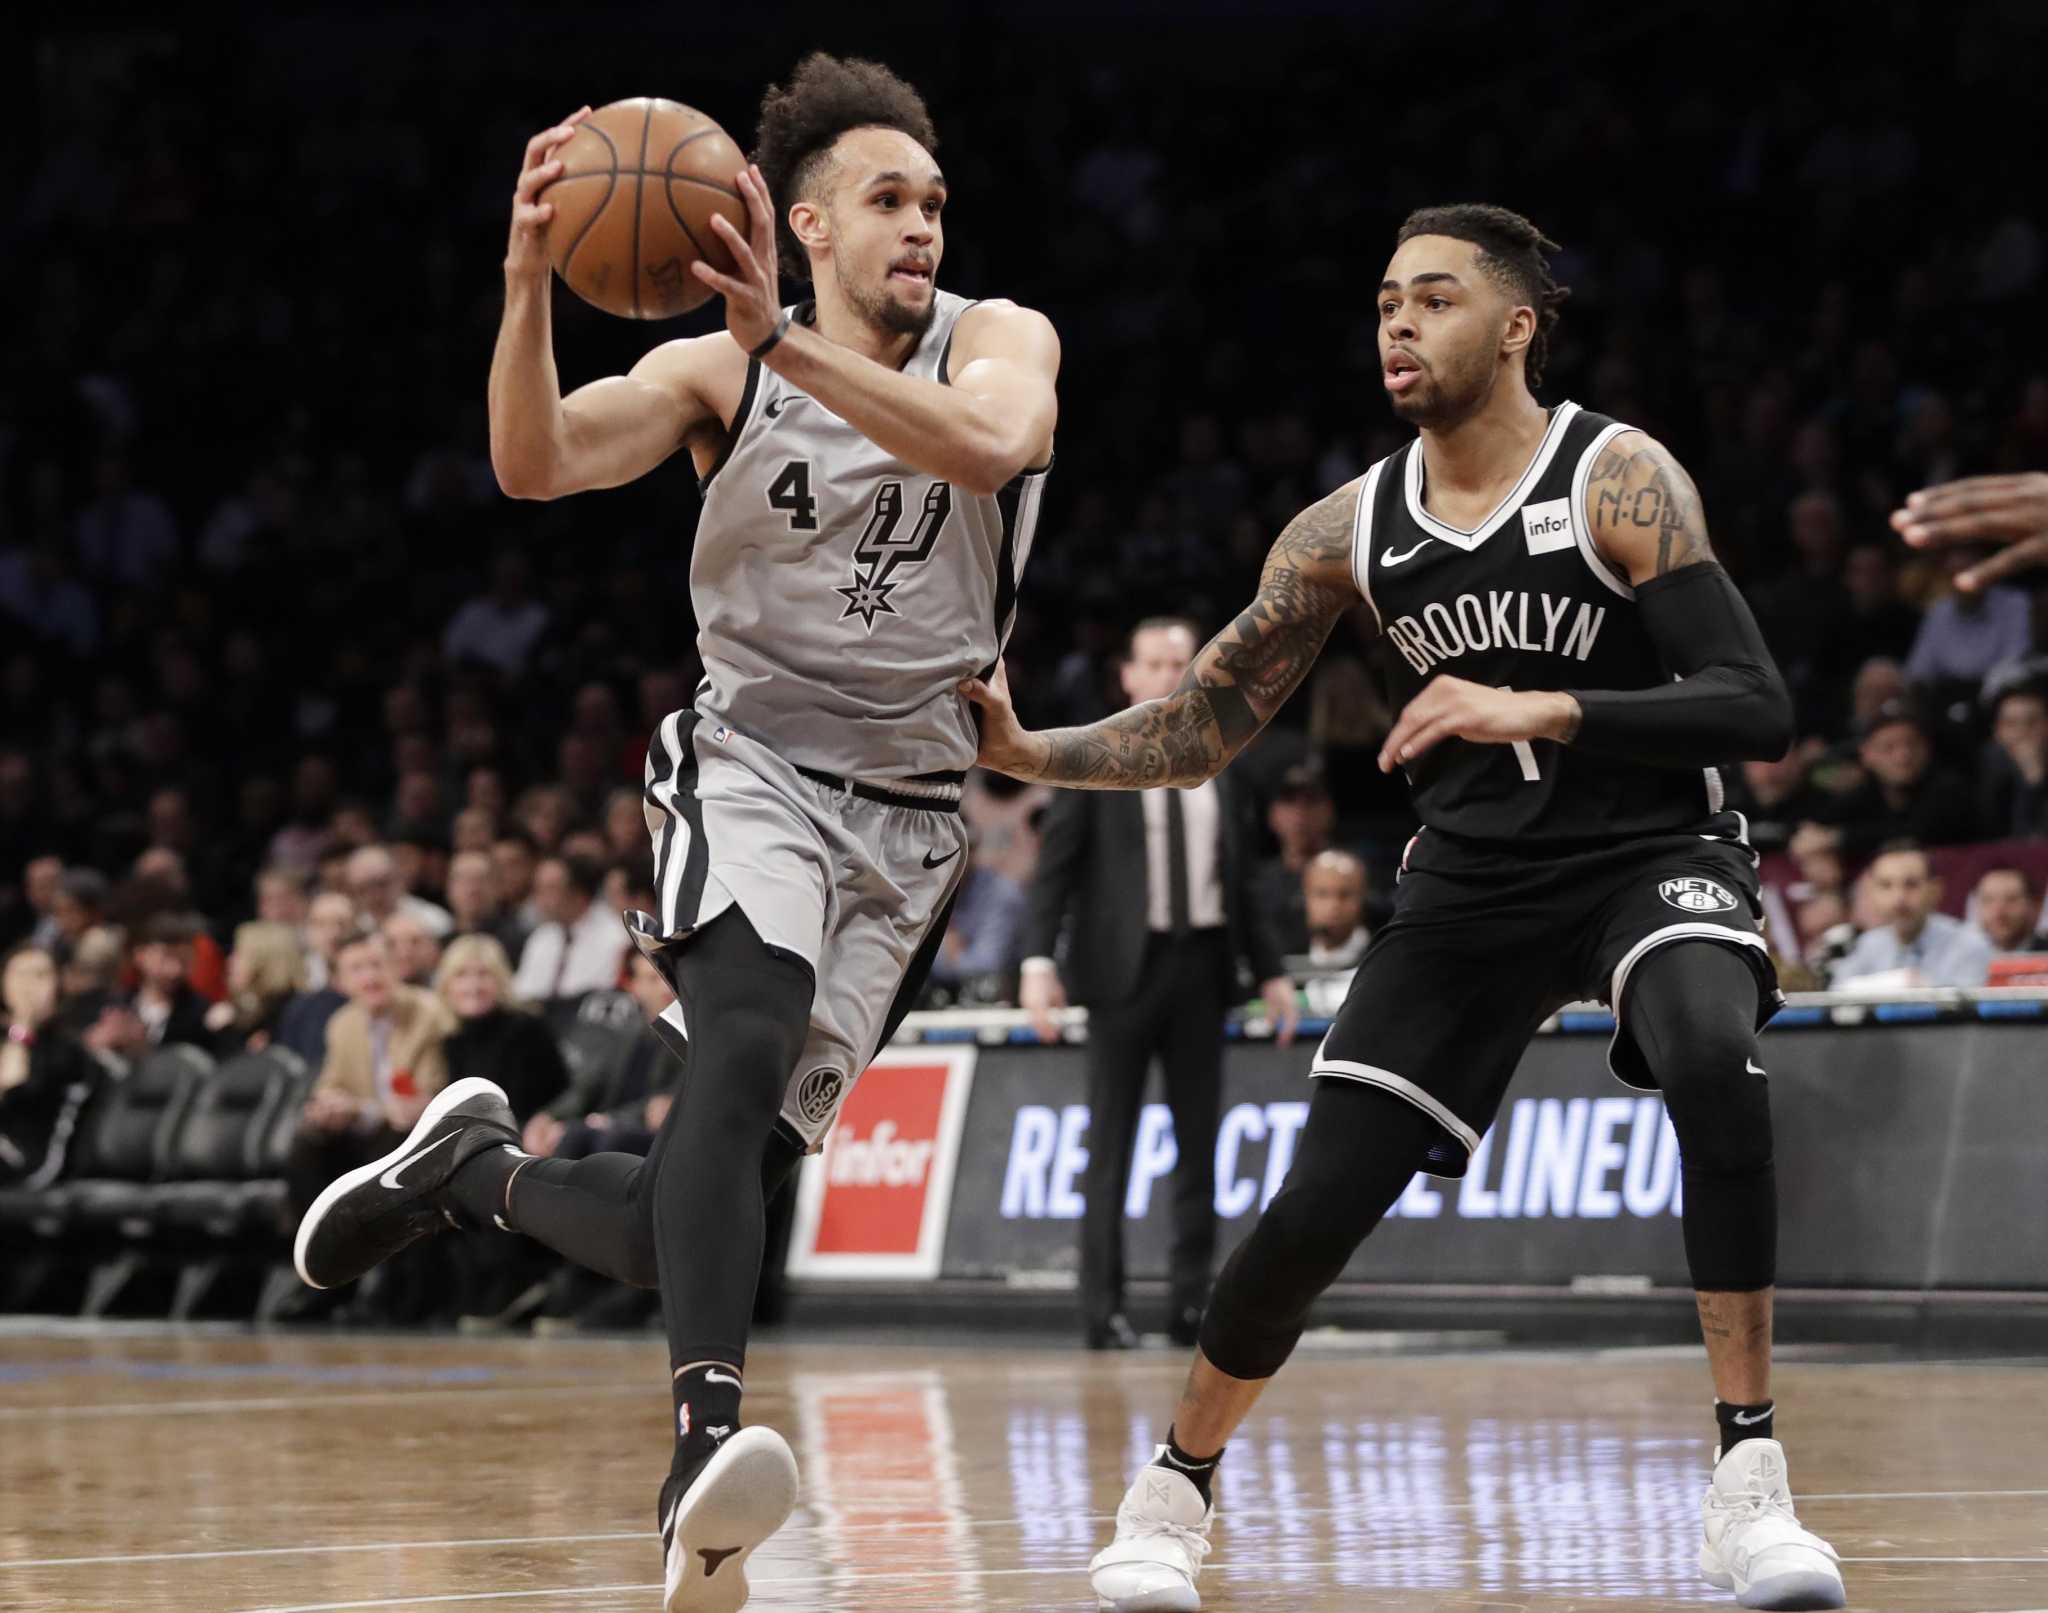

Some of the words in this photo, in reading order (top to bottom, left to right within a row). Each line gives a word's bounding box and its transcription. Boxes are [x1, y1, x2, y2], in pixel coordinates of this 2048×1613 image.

[766, 459, 820, 533] 4
[1529, 516, 1568, 536] infor
[1387, 591, 1606, 676] BROOKLYN
[1664, 880, 1735, 905] NETS
[829, 1119, 936, 1188] infor
[1000, 1101, 1311, 1219] REPCT
[1457, 1097, 1683, 1218] LINEU
